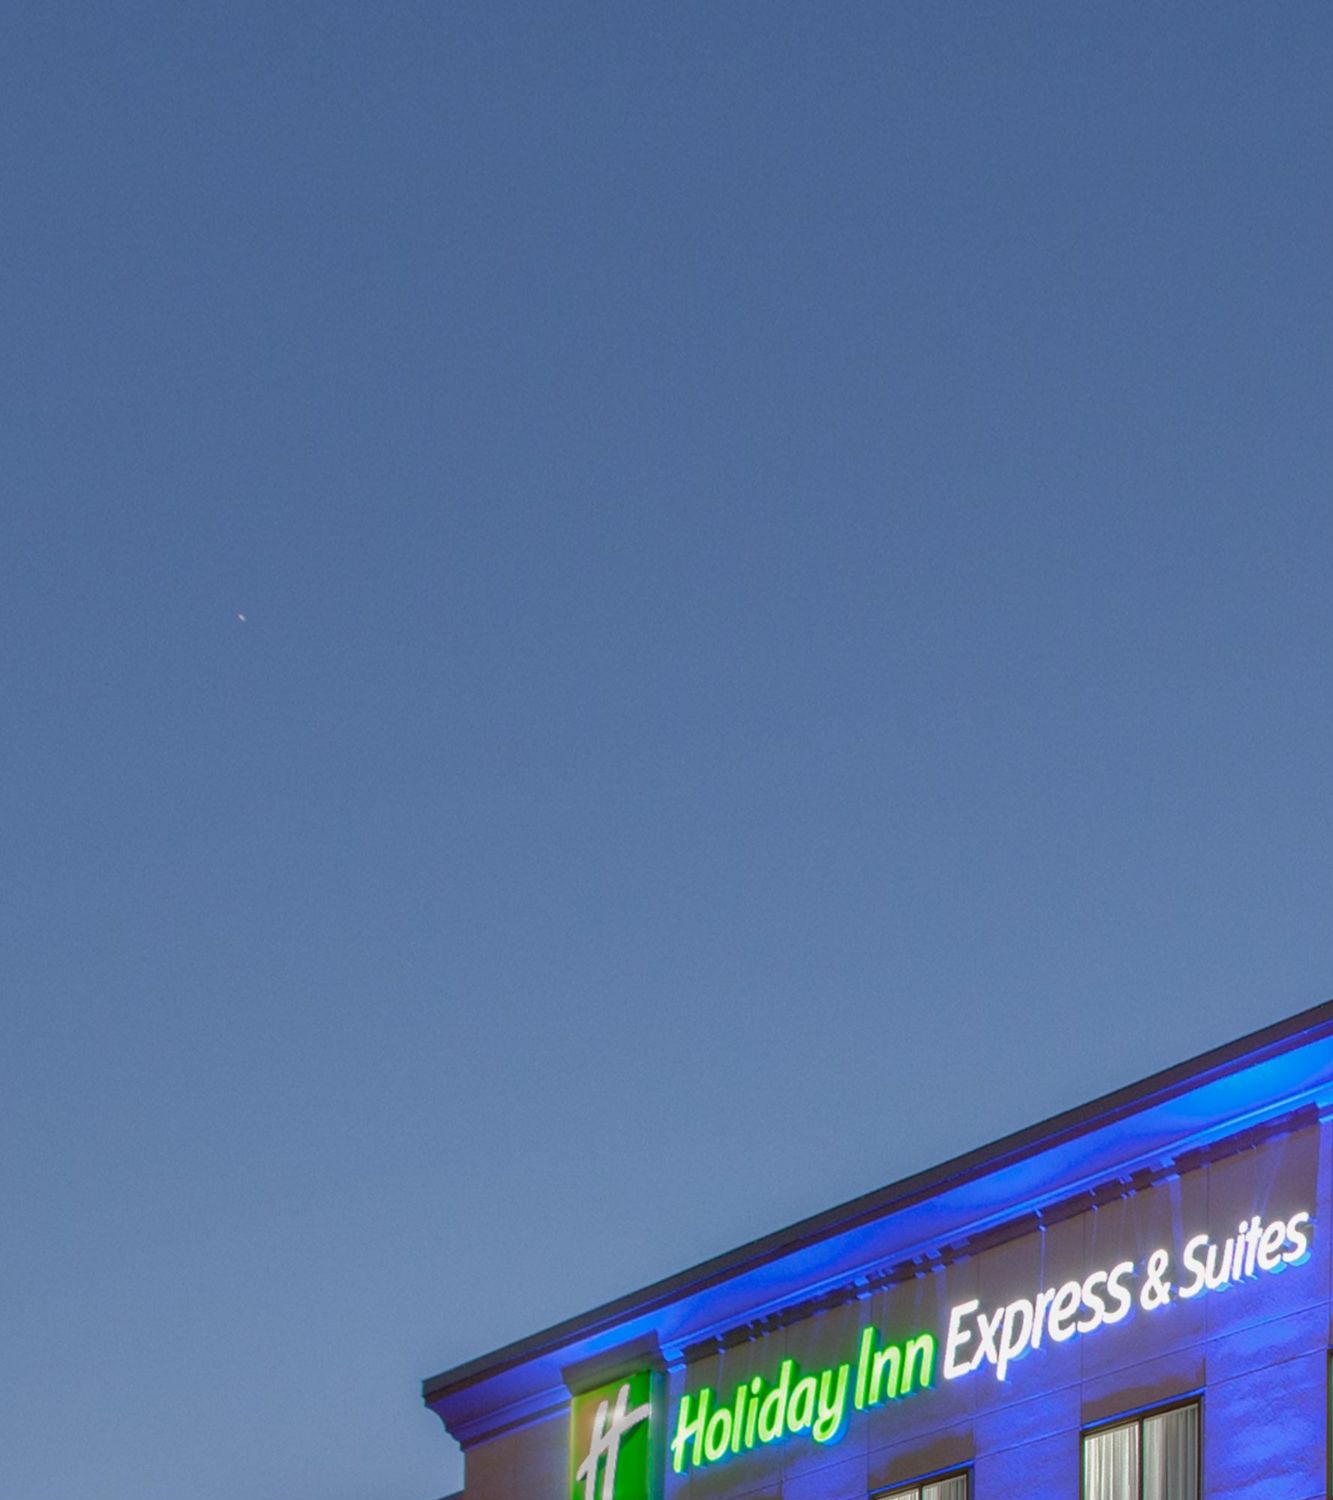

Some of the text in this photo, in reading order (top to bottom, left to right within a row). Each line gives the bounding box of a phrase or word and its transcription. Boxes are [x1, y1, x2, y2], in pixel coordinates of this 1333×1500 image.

[671, 1211, 1310, 1473] Holiday Inn Express & Suites
